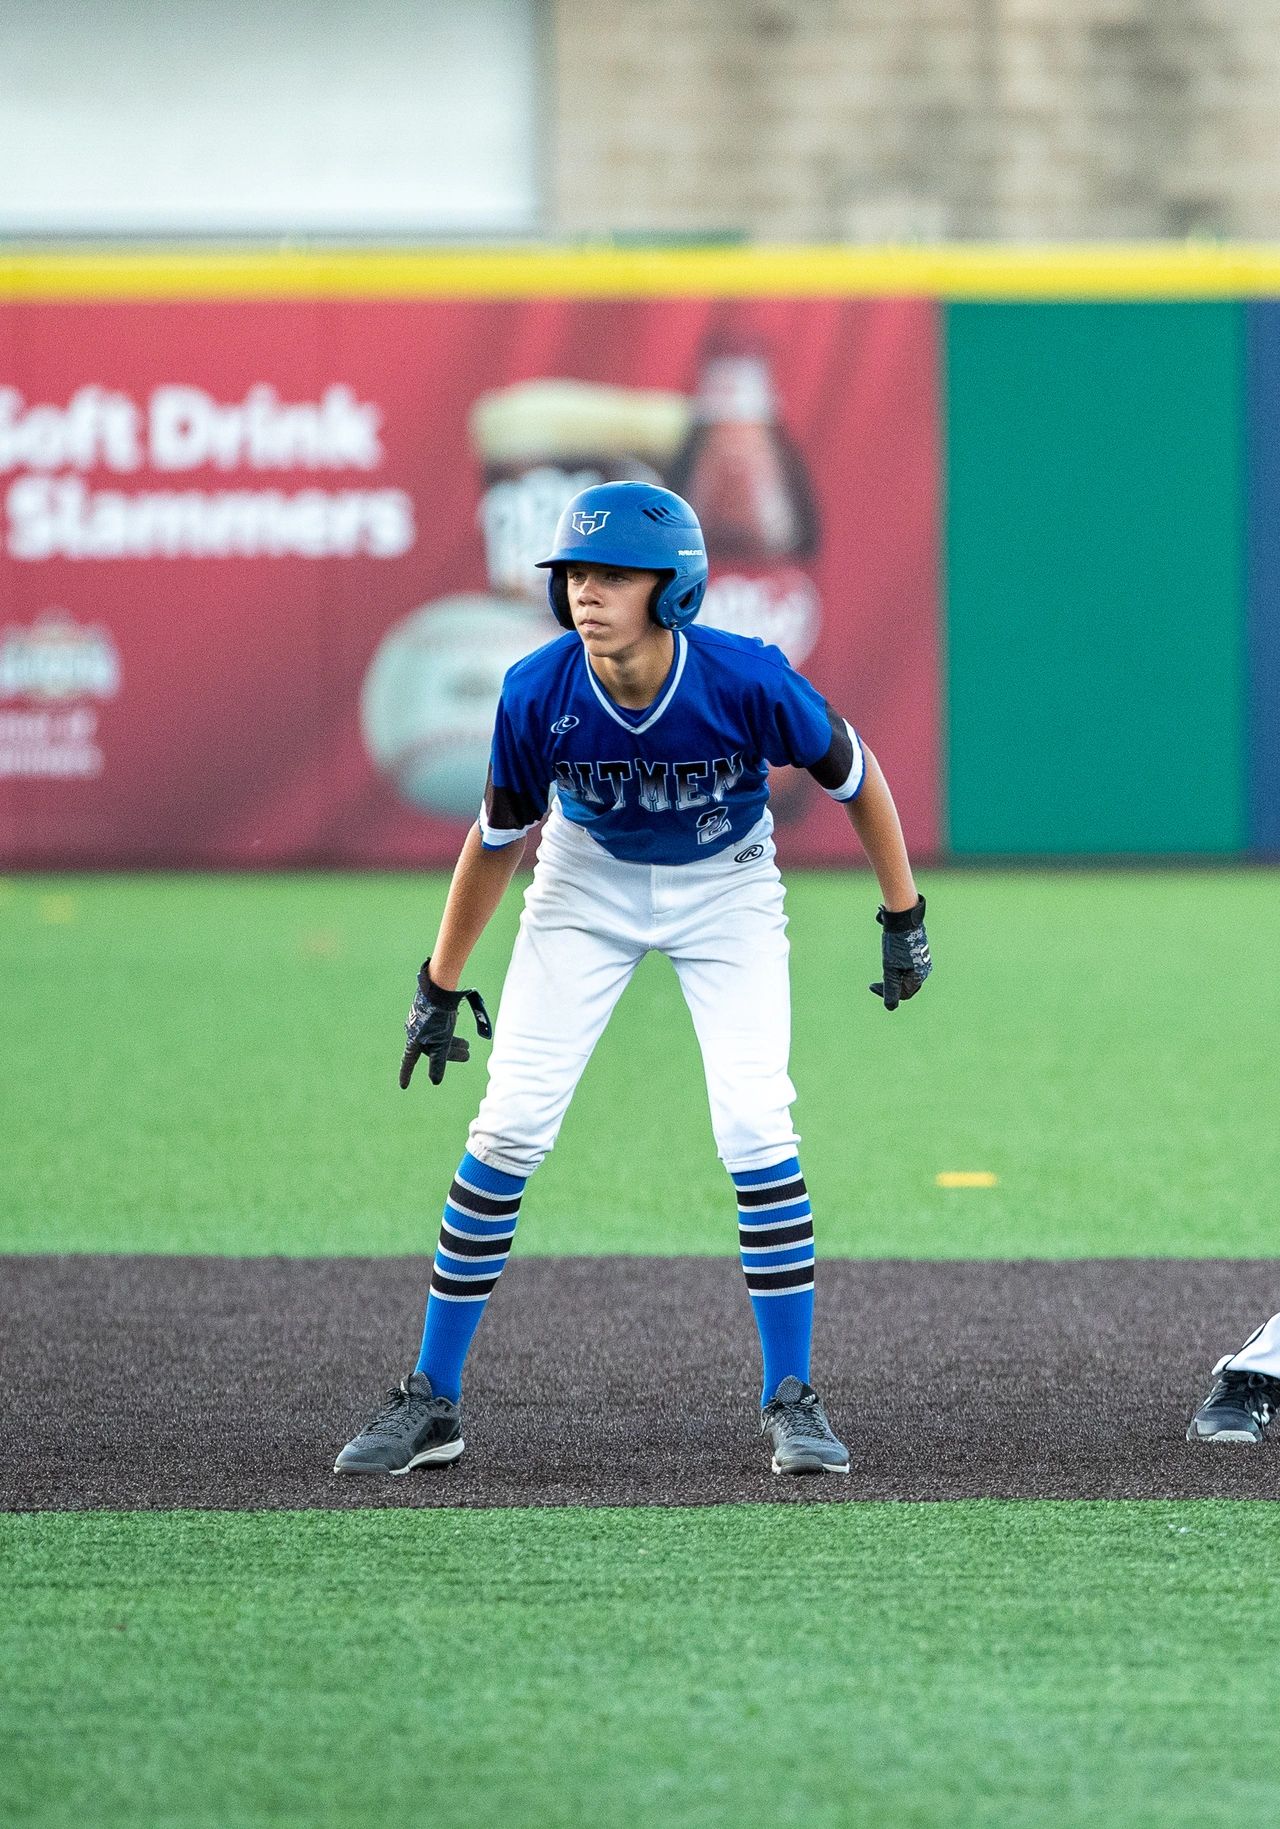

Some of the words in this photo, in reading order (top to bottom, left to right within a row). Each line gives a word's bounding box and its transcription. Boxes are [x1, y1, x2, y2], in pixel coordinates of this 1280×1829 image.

[152, 385, 382, 471] Drink
[9, 475, 414, 559] Slammers
[696, 806, 732, 845] 2
